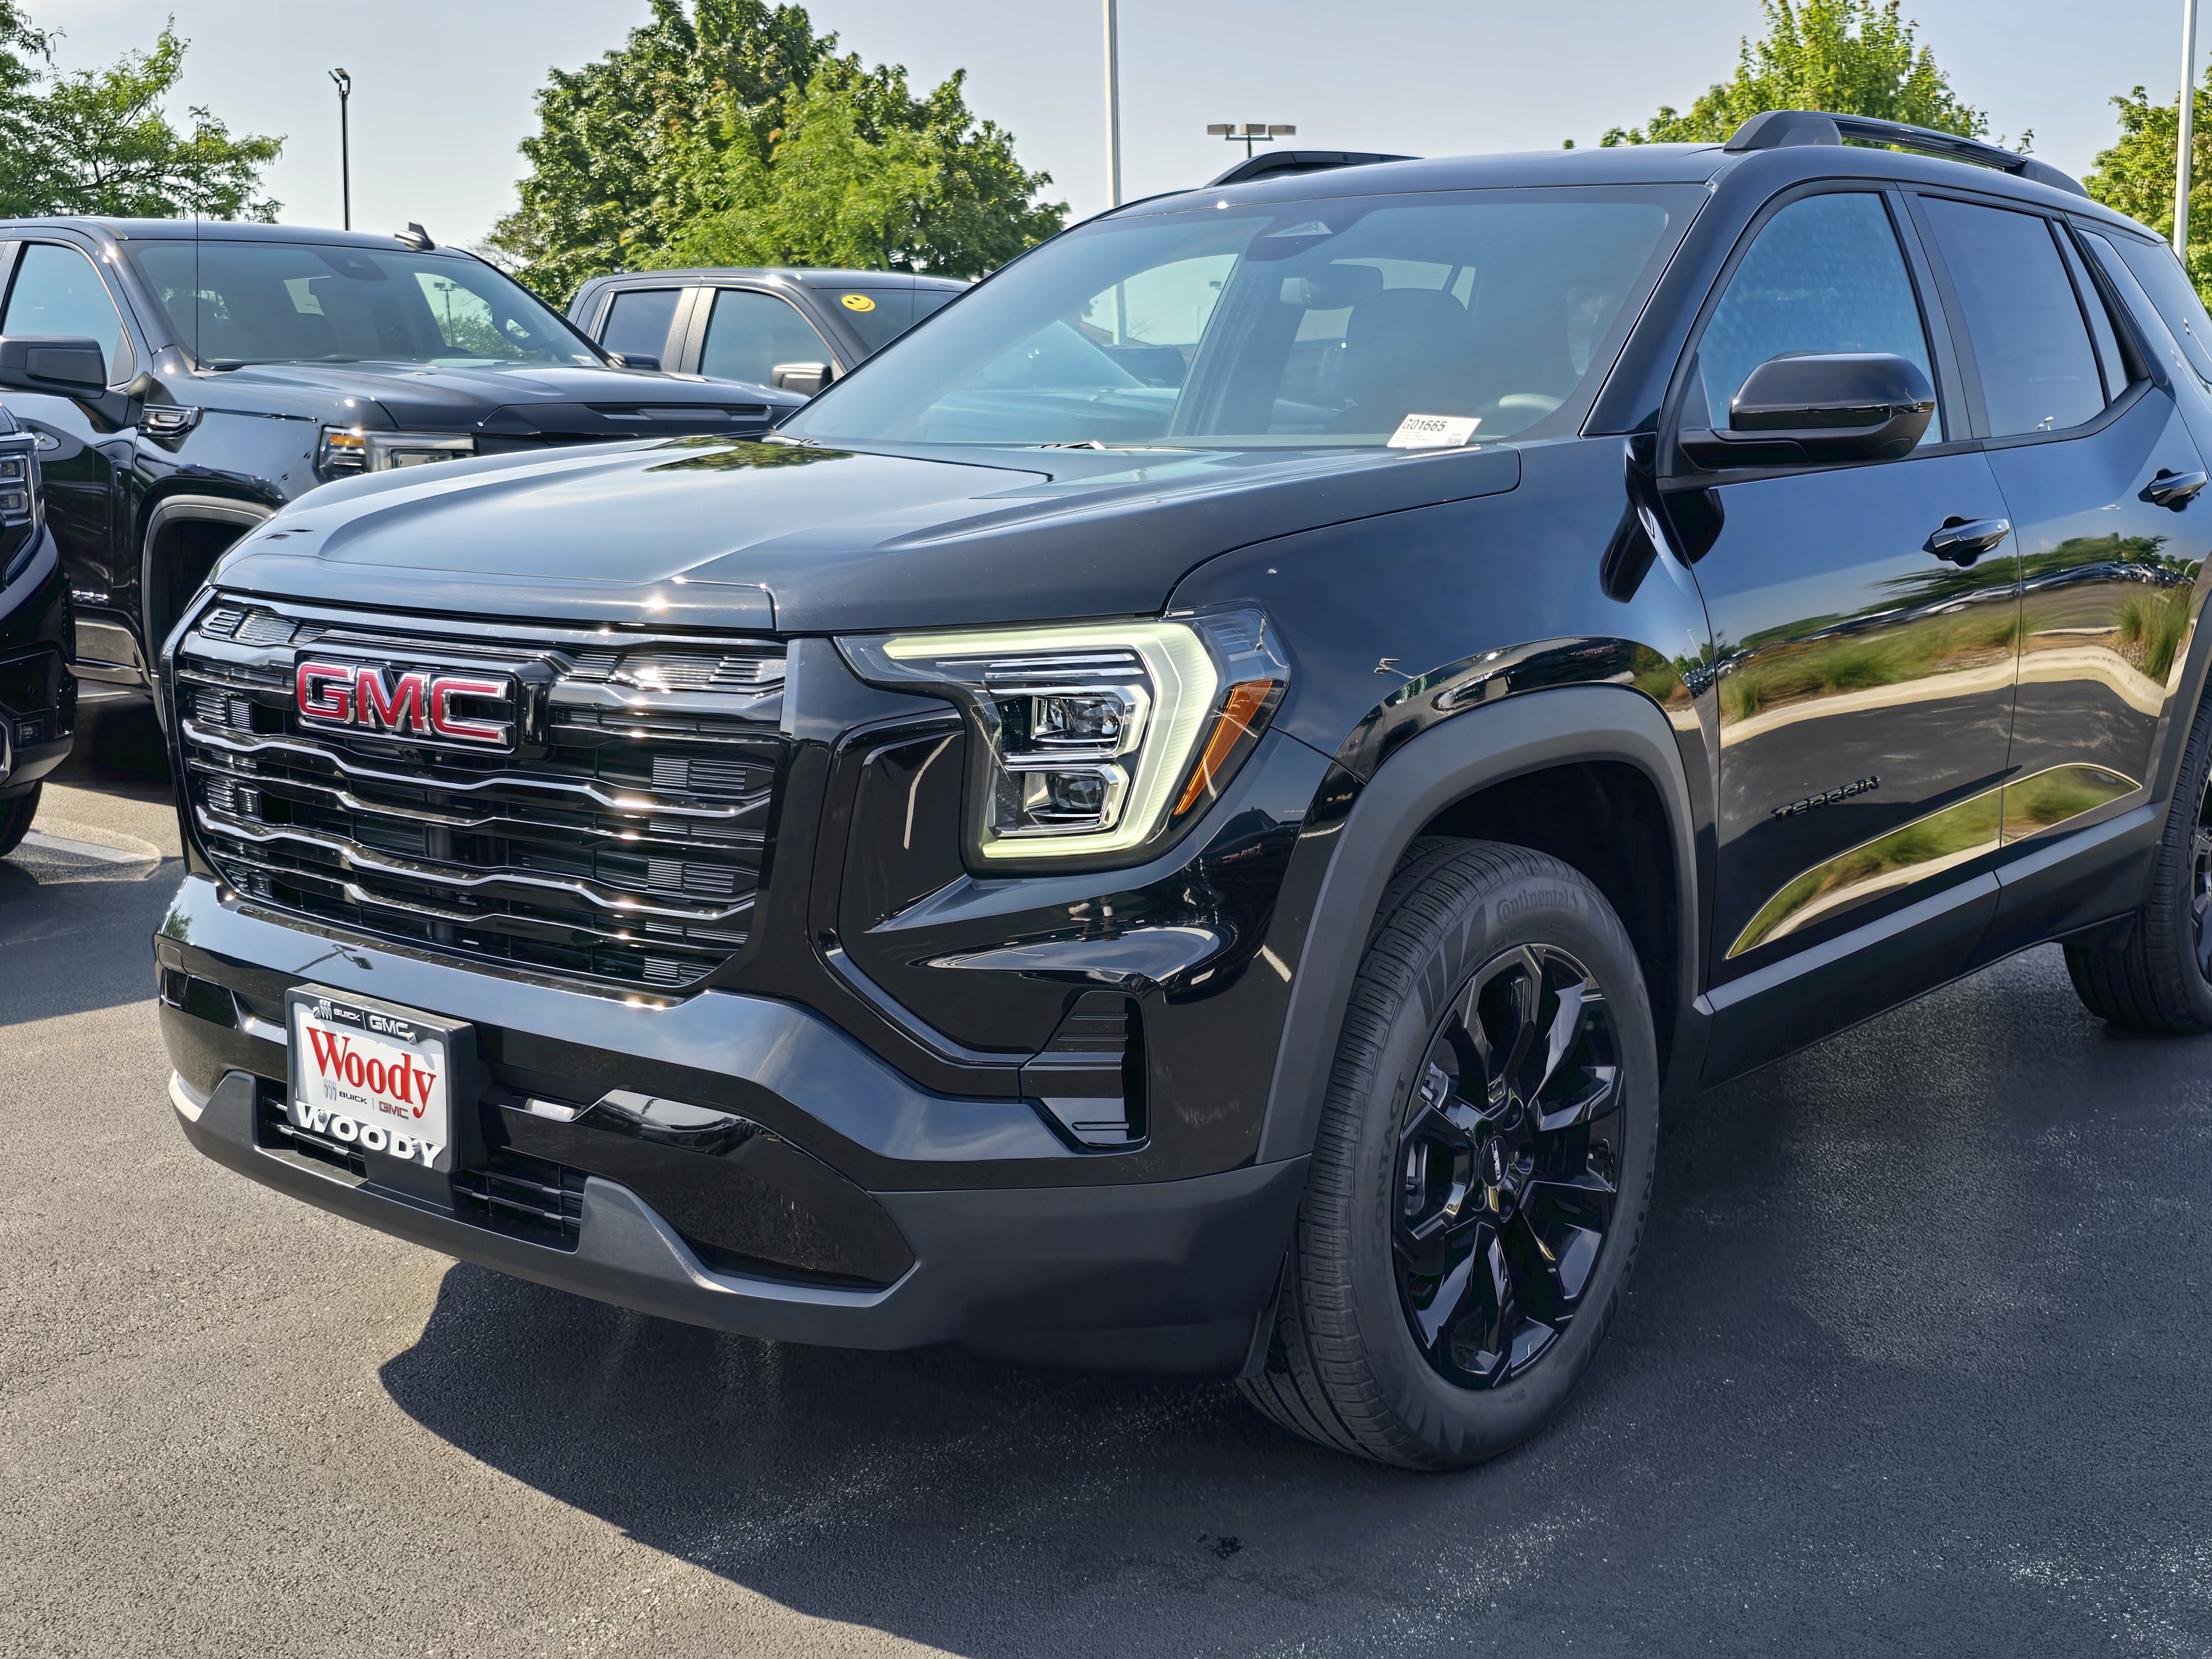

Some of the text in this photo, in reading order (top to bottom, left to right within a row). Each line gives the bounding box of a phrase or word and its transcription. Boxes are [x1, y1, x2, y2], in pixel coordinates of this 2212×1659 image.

[298, 660, 509, 745] GMC
[1498, 888, 1568, 924] Continental
[333, 1008, 411, 1035] BUICK GMC
[306, 1026, 437, 1118] Woody
[339, 1091, 409, 1120] BUICK GMC
[296, 1103, 445, 1168] WOODY
